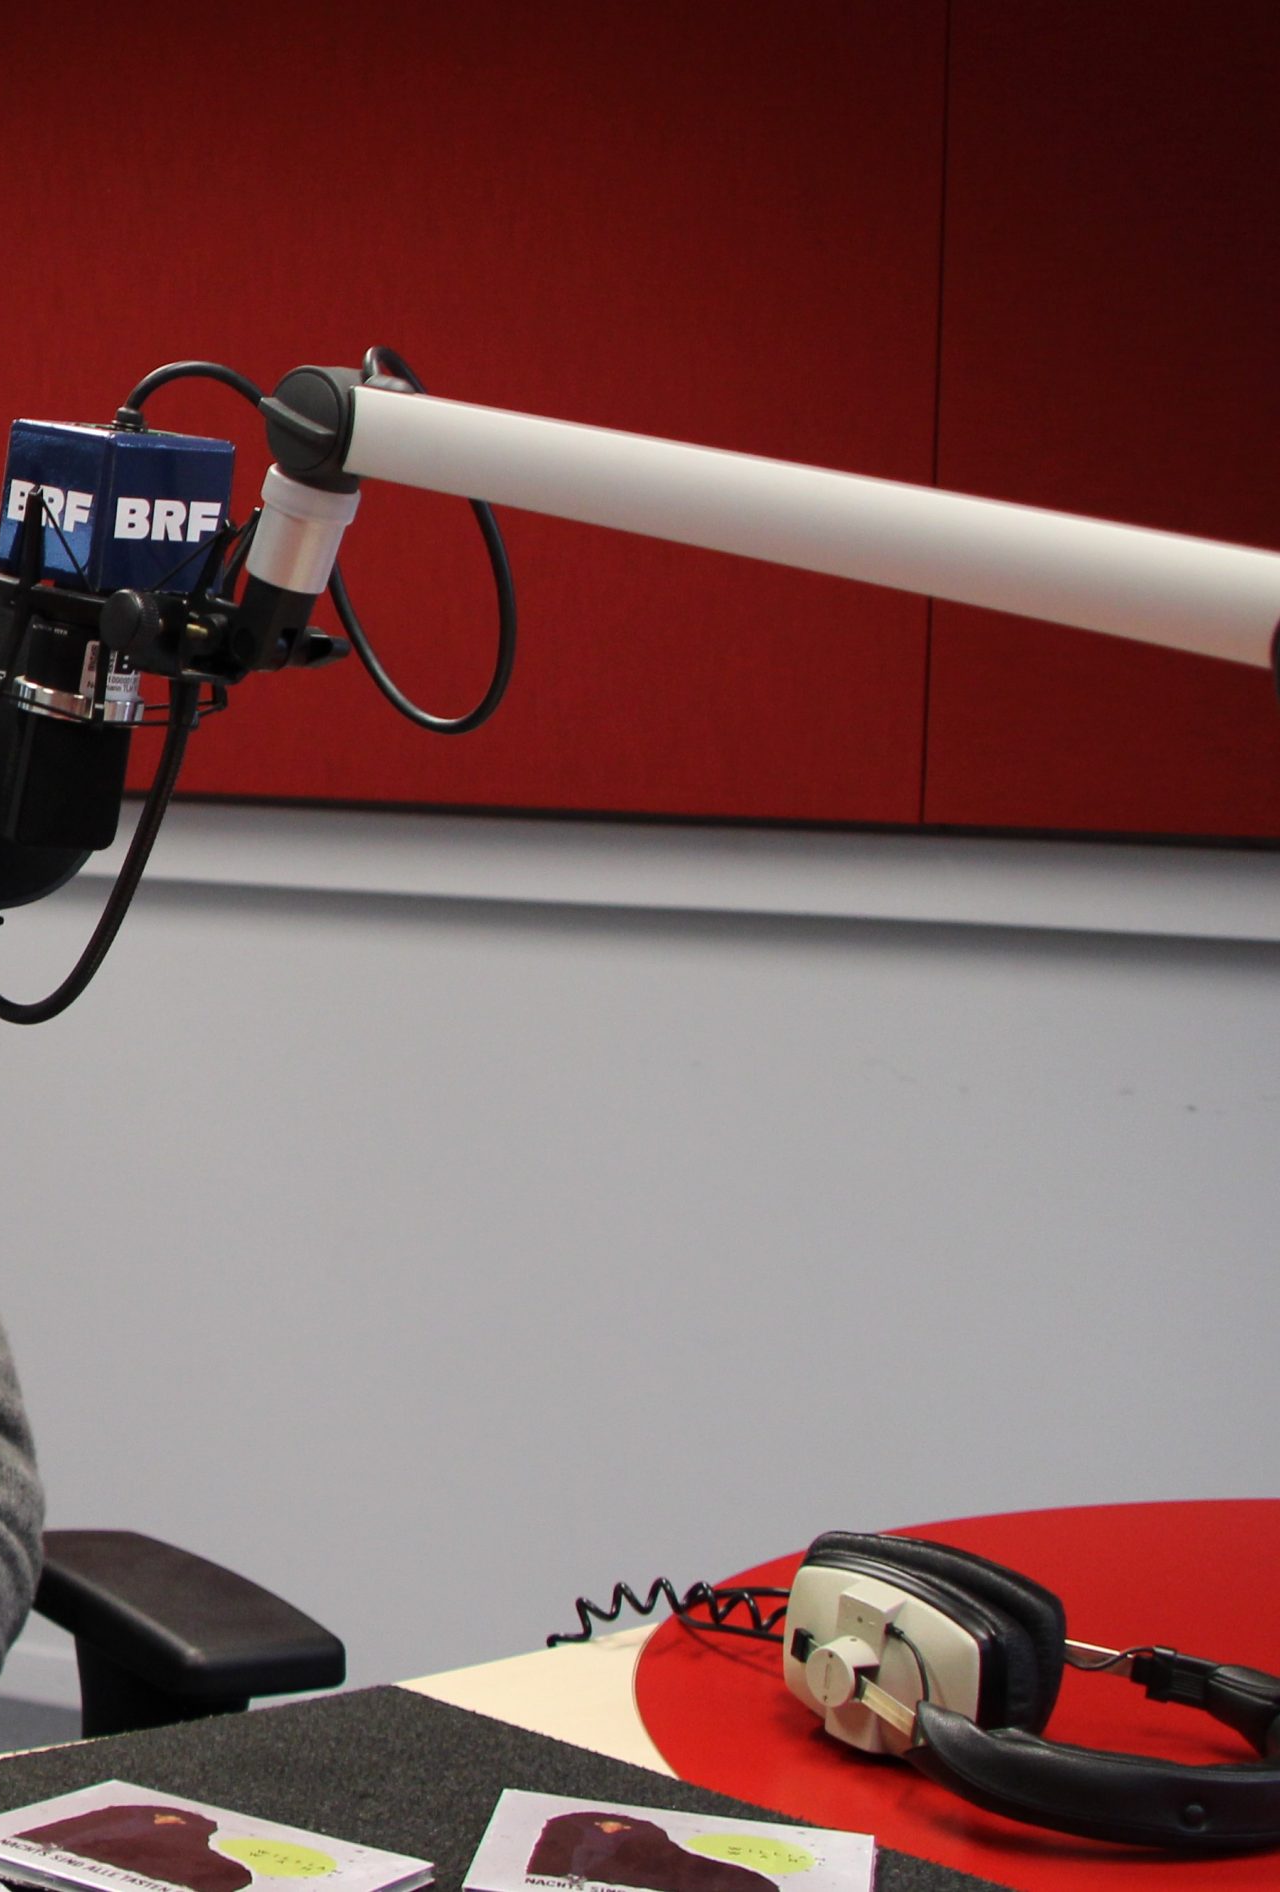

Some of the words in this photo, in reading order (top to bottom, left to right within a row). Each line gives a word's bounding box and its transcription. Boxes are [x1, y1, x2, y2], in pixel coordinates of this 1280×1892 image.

[7, 479, 93, 532] BRF
[114, 497, 222, 542] BRF
[52, 1854, 85, 1867] SIND
[85, 1864, 117, 1878] ALLE
[524, 1877, 584, 1891] NACHTS
